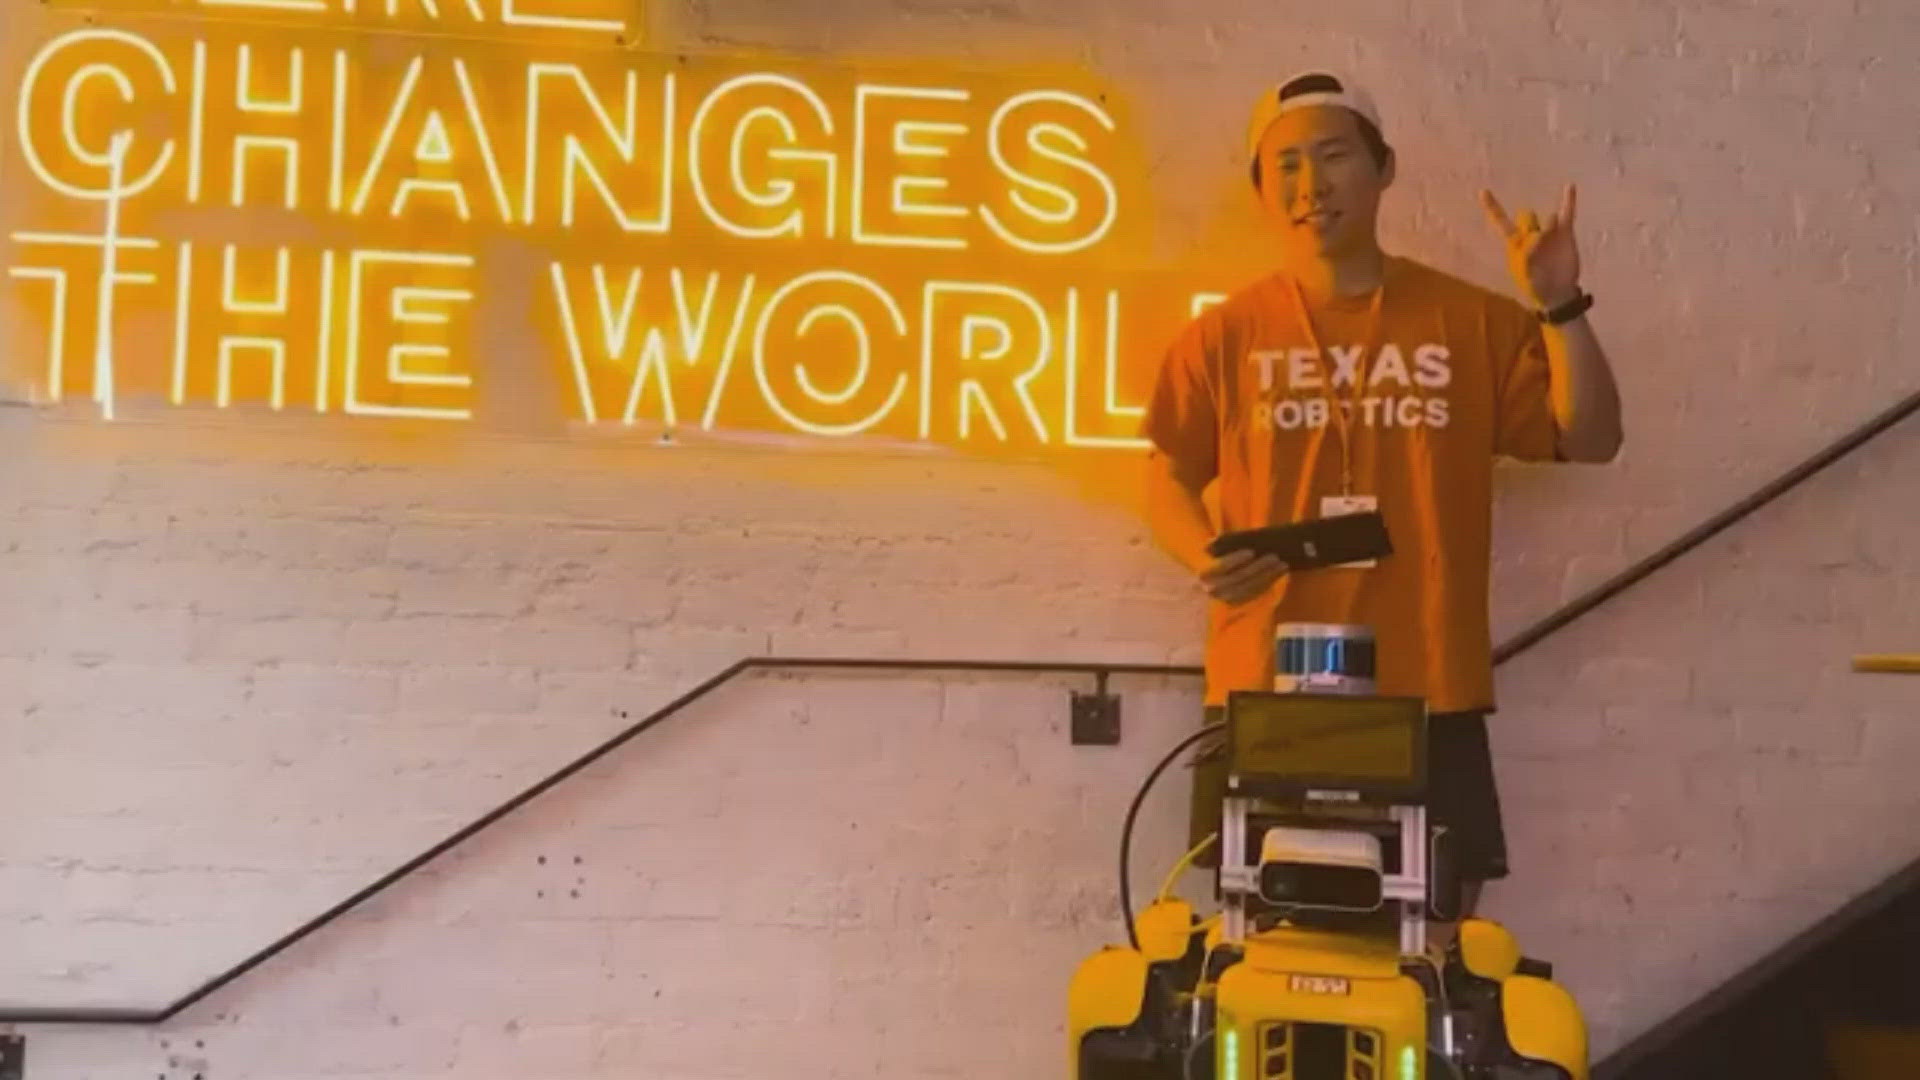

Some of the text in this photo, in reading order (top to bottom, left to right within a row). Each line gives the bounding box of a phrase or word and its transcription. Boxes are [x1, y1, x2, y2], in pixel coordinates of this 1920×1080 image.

[18, 29, 1117, 254] CHANGES
[9, 231, 1227, 449] THE WORL
[1248, 343, 1451, 392] TEXAS
[1252, 396, 1450, 430] ROBTICS
